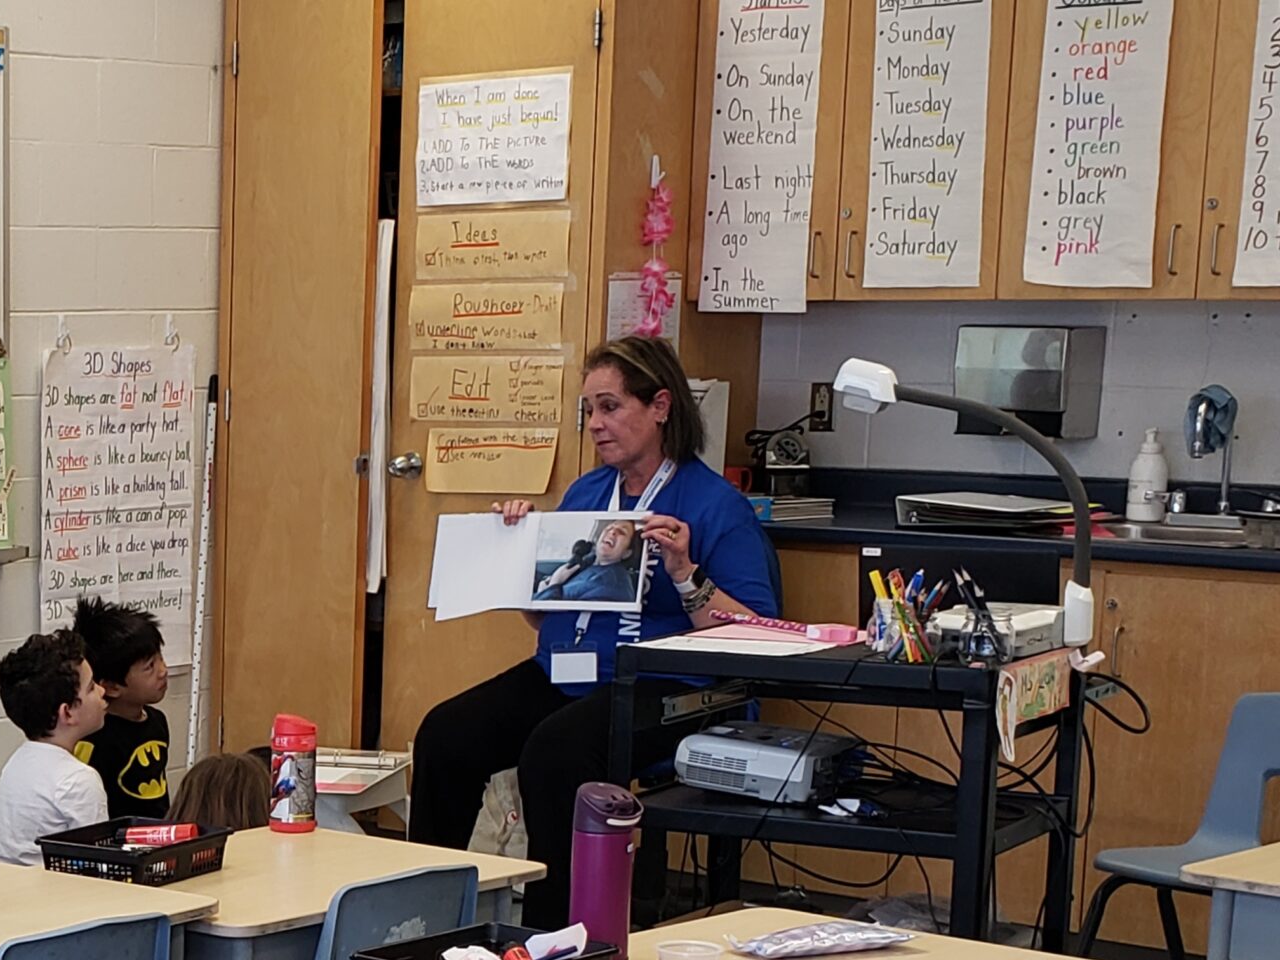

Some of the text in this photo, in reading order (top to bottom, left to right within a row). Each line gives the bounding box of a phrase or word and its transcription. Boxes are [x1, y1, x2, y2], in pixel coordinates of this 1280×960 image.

[730, 12, 810, 53] Yesterday
[888, 16, 956, 51] Sunday
[1074, 7, 1149, 42] yellow
[1069, 39, 1138, 65] orange
[726, 61, 814, 101] On Sunday
[887, 54, 950, 86] Monday
[1074, 56, 1108, 81] red
[1263, 71, 1277, 93] 4
[435, 83, 540, 105] When I am done
[883, 88, 952, 124] Tuesday
[1063, 83, 1105, 105] blue
[441, 102, 558, 132] I have just begun!
[728, 95, 803, 123] On the
[1254, 96, 1273, 121] 5
[723, 120, 796, 145] weekend
[1065, 104, 1125, 142] purple
[1256, 122, 1269, 147] 6
[881, 124, 965, 158] Wednesday
[1065, 140, 1120, 167] green
[1078, 157, 1126, 180] brown
[1257, 151, 1269, 173] 7
[723, 163, 813, 199] Last night
[879, 158, 958, 196] Thursday
[1253, 176, 1266, 198] 8
[1058, 179, 1107, 205] black
[716, 199, 808, 237] A long time
[882, 196, 940, 230] Friday
[1253, 201, 1263, 223] 9
[451, 221, 498, 243] Ideas
[1058, 214, 1103, 244] grey
[1244, 227, 1268, 251] 10
[722, 233, 748, 259] ago
[875, 229, 958, 266] Saturday
[1055, 228, 1100, 266] pink
[711, 267, 765, 292] In the
[83, 352, 152, 381] 3D Shapes
[45, 385, 59, 407] 3D
[64, 385, 96, 412] shapes
[100, 394, 116, 404] are
[121, 382, 137, 403] fat
[142, 382, 157, 403] not
[45, 416, 53, 438] A
[86, 421, 94, 435] is
[99, 415, 116, 435] like
[118, 423, 125, 433] a
[130, 413, 156, 443] party
[45, 442, 170, 477] A sphere is like a bouncy
[46, 478, 53, 499] A
[59, 483, 86, 506] prism
[91, 485, 99, 496] is
[105, 476, 120, 495] like
[123, 484, 130, 493] a
[133, 474, 165, 500] building
[136, 511, 152, 522] can
[126, 535, 146, 552] dice
[151, 540, 166, 557] you
